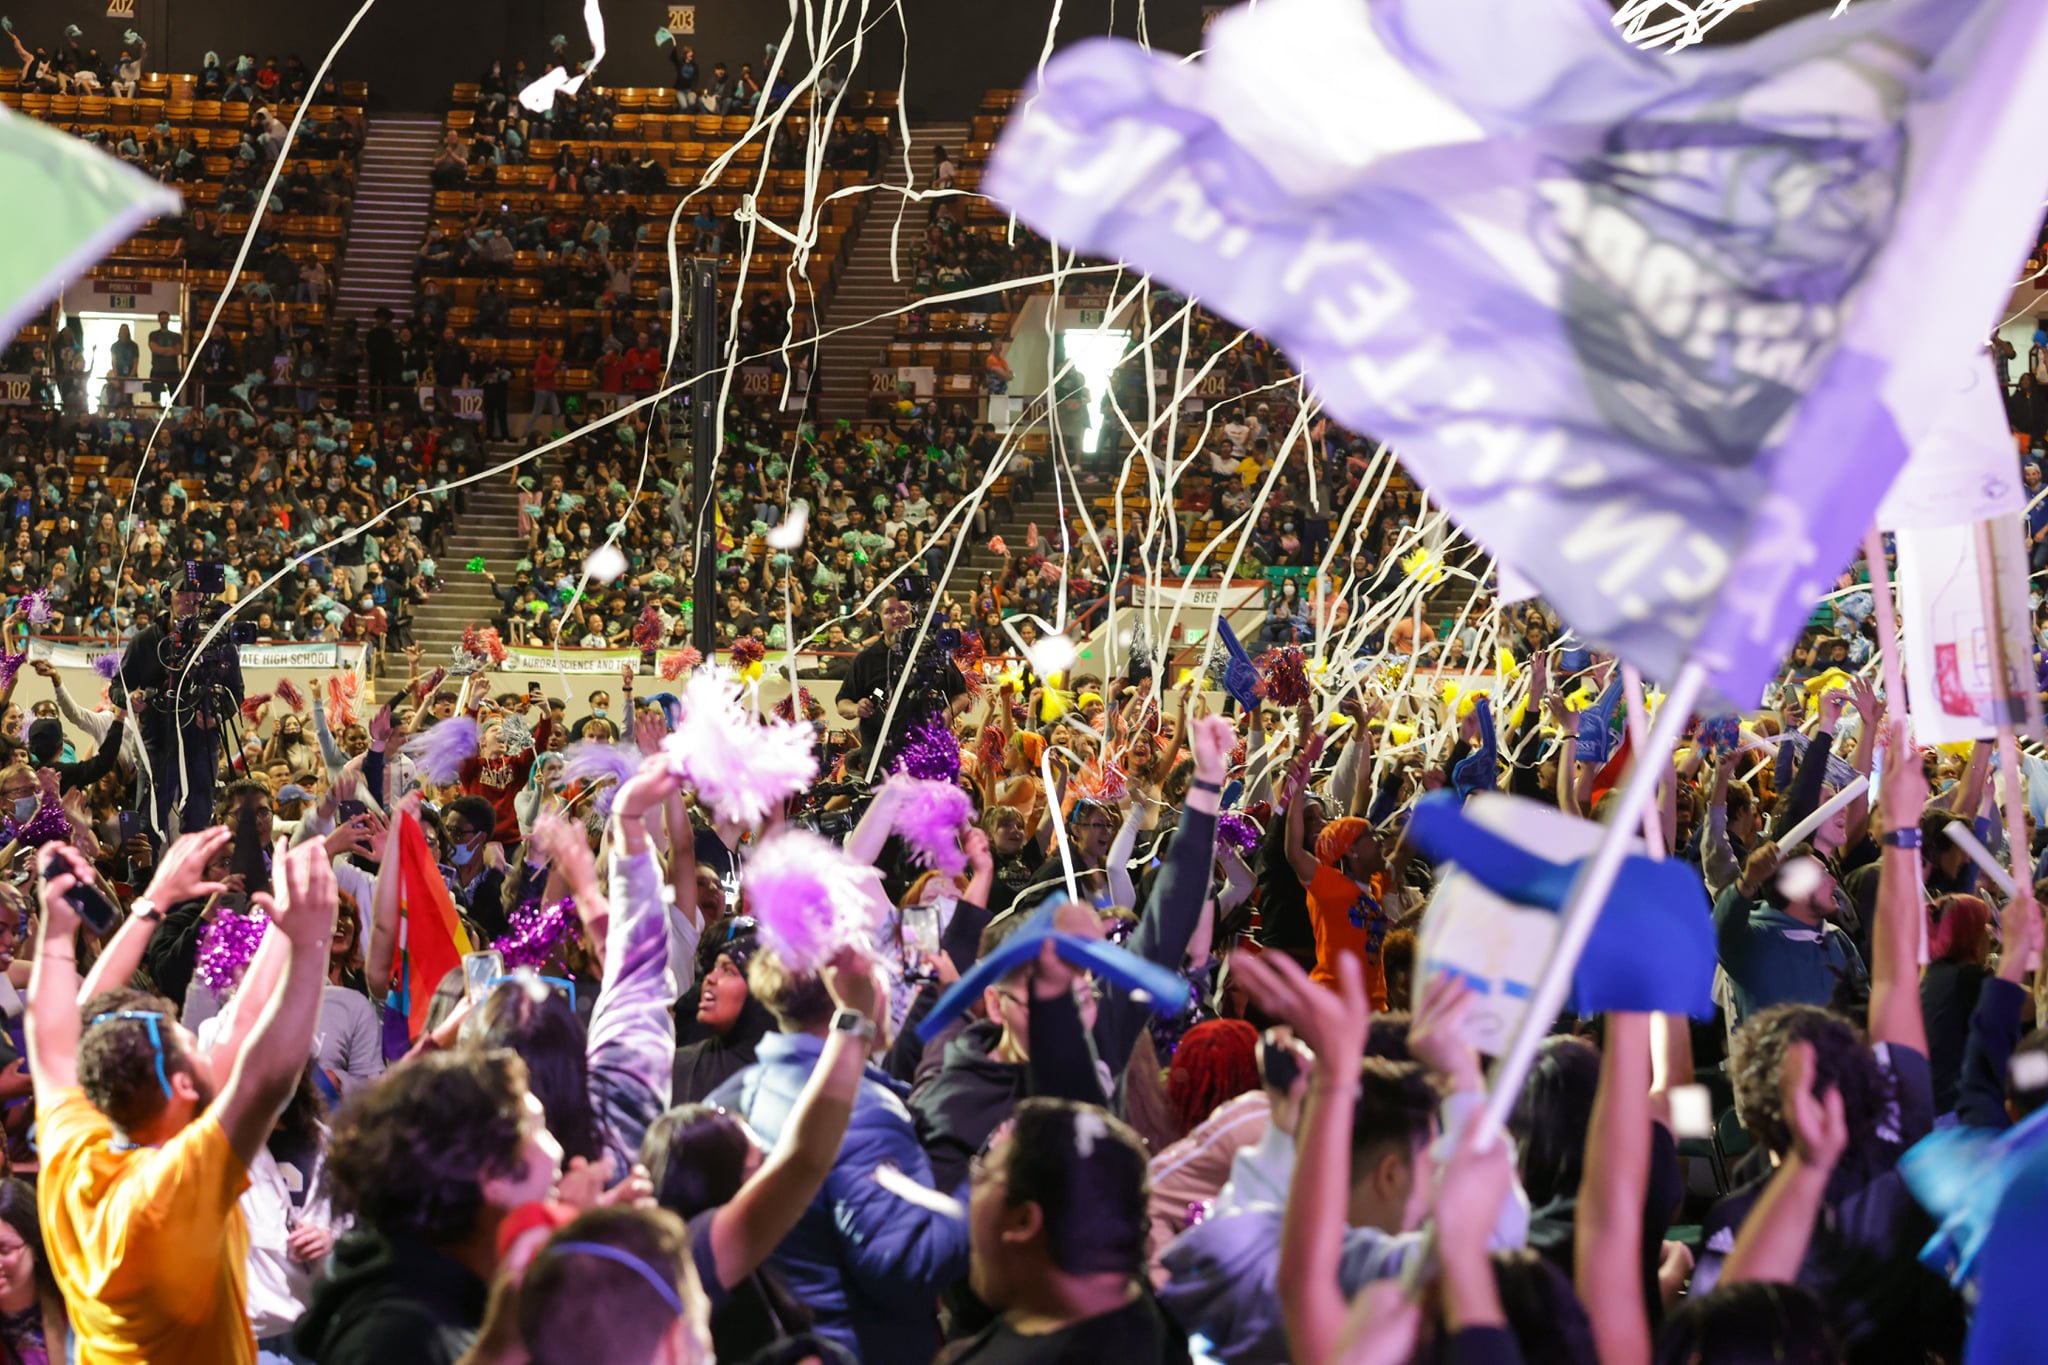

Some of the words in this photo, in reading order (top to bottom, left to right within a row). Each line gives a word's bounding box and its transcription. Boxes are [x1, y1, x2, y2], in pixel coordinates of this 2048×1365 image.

[668, 10, 695, 30] 203
[6, 381, 31, 400] 102
[743, 373, 769, 392] 203
[872, 373, 896, 392] 204
[1199, 376, 1226, 395] 204
[458, 395, 483, 414] 102
[262, 654, 288, 665] HIGH
[290, 652, 330, 665] SCHOOL
[522, 657, 557, 669] AURORA
[559, 659, 594, 671] SCIENCE
[596, 659, 614, 671] AND
